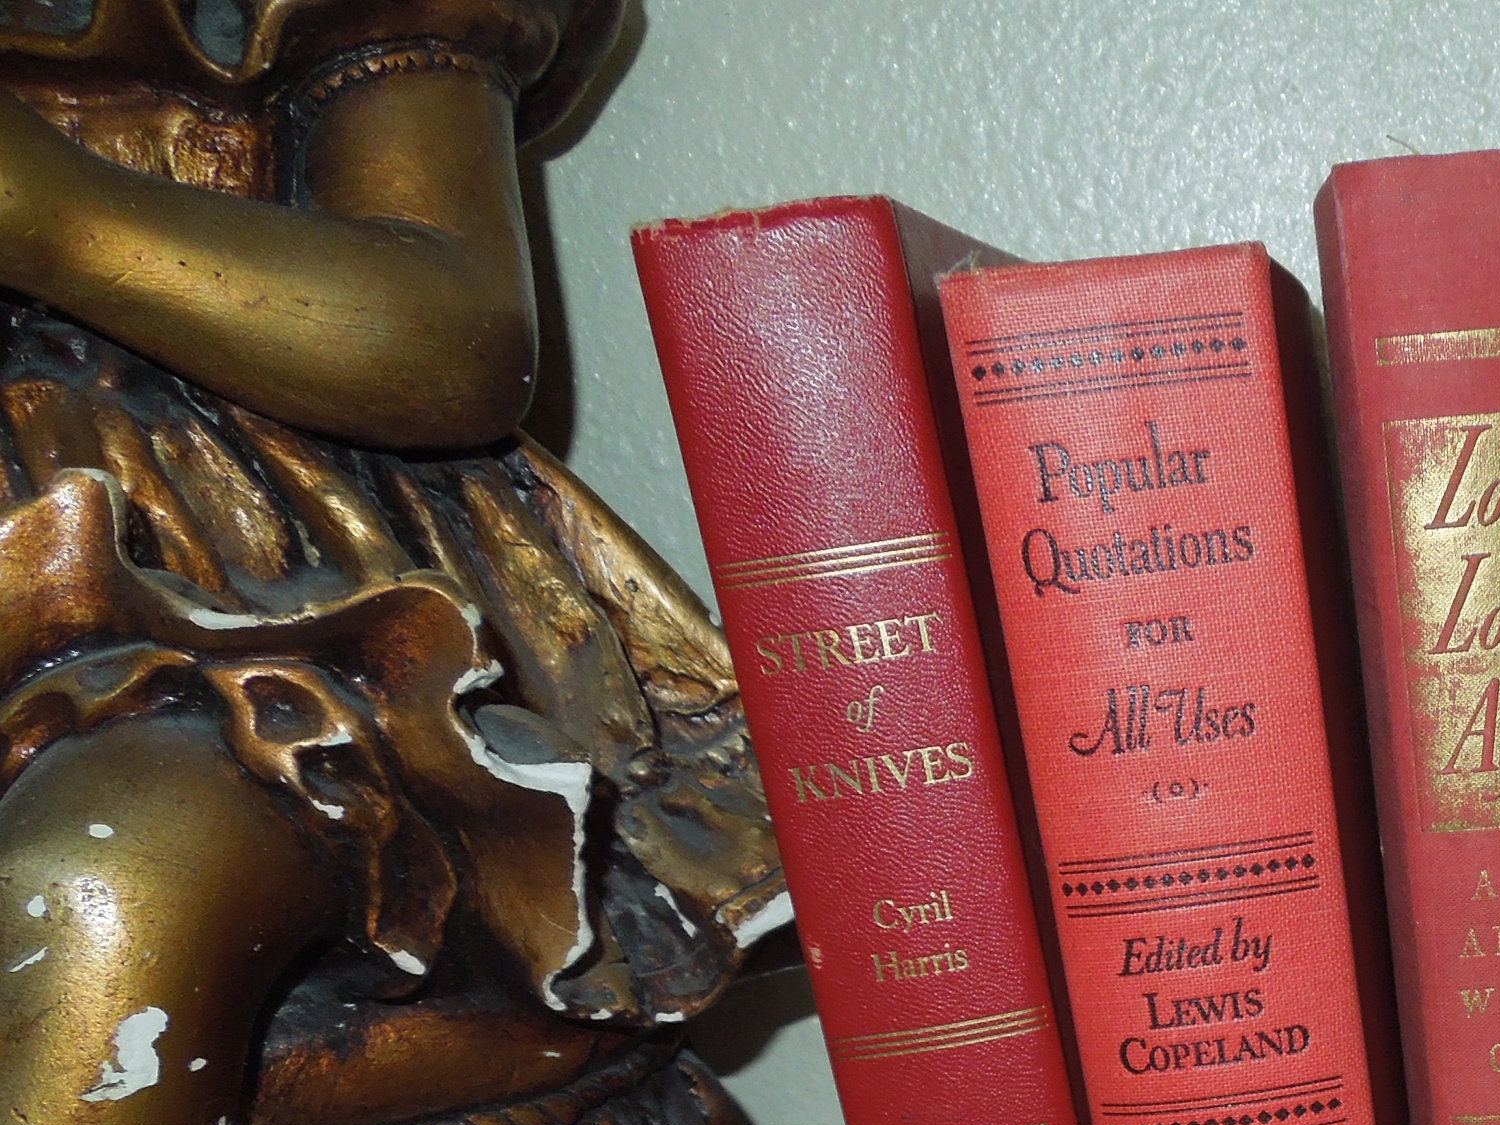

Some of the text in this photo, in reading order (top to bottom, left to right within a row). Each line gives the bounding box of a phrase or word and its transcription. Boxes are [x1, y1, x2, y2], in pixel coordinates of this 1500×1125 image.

[1028, 420, 1211, 513] Popular
[1021, 524, 1256, 597] Quotations
[754, 612, 943, 675] STREET
[1124, 616, 1195, 648] FOR
[846, 685, 884, 733] of
[1069, 684, 1257, 757] All Uses
[788, 741, 974, 803] KNIVES
[872, 890, 954, 933] Cyril
[870, 942, 970, 983] Harris
[1117, 917, 1274, 978] Edited by
[1143, 988, 1265, 1030] LEWIS
[1119, 1025, 1311, 1075] COPELAND
